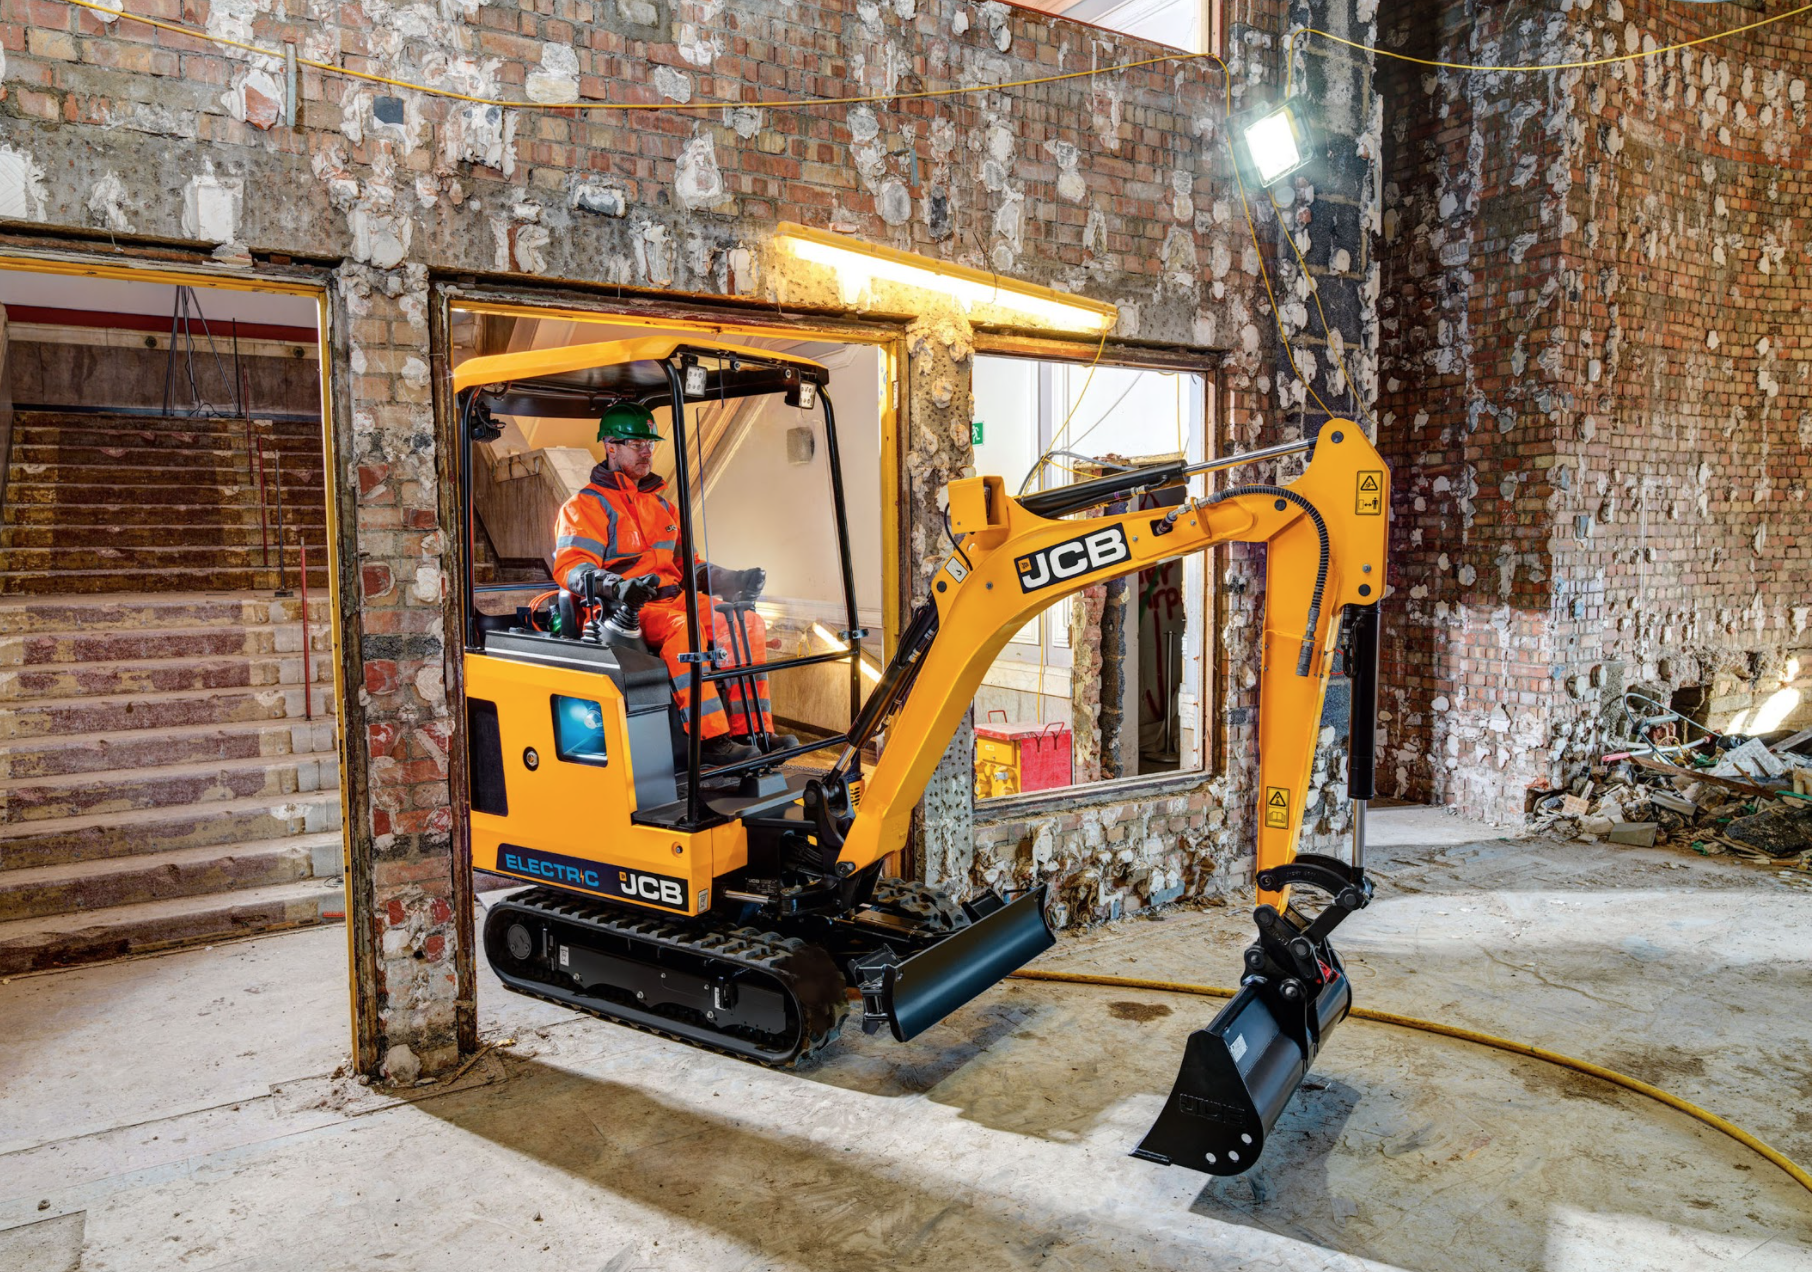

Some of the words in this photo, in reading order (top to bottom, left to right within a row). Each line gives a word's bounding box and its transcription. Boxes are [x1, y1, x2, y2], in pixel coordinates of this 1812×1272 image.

[667, 524, 678, 532] JC
[1022, 529, 1127, 589] JCB
[620, 873, 683, 905] JCB
[1179, 1093, 1247, 1126] JCB
